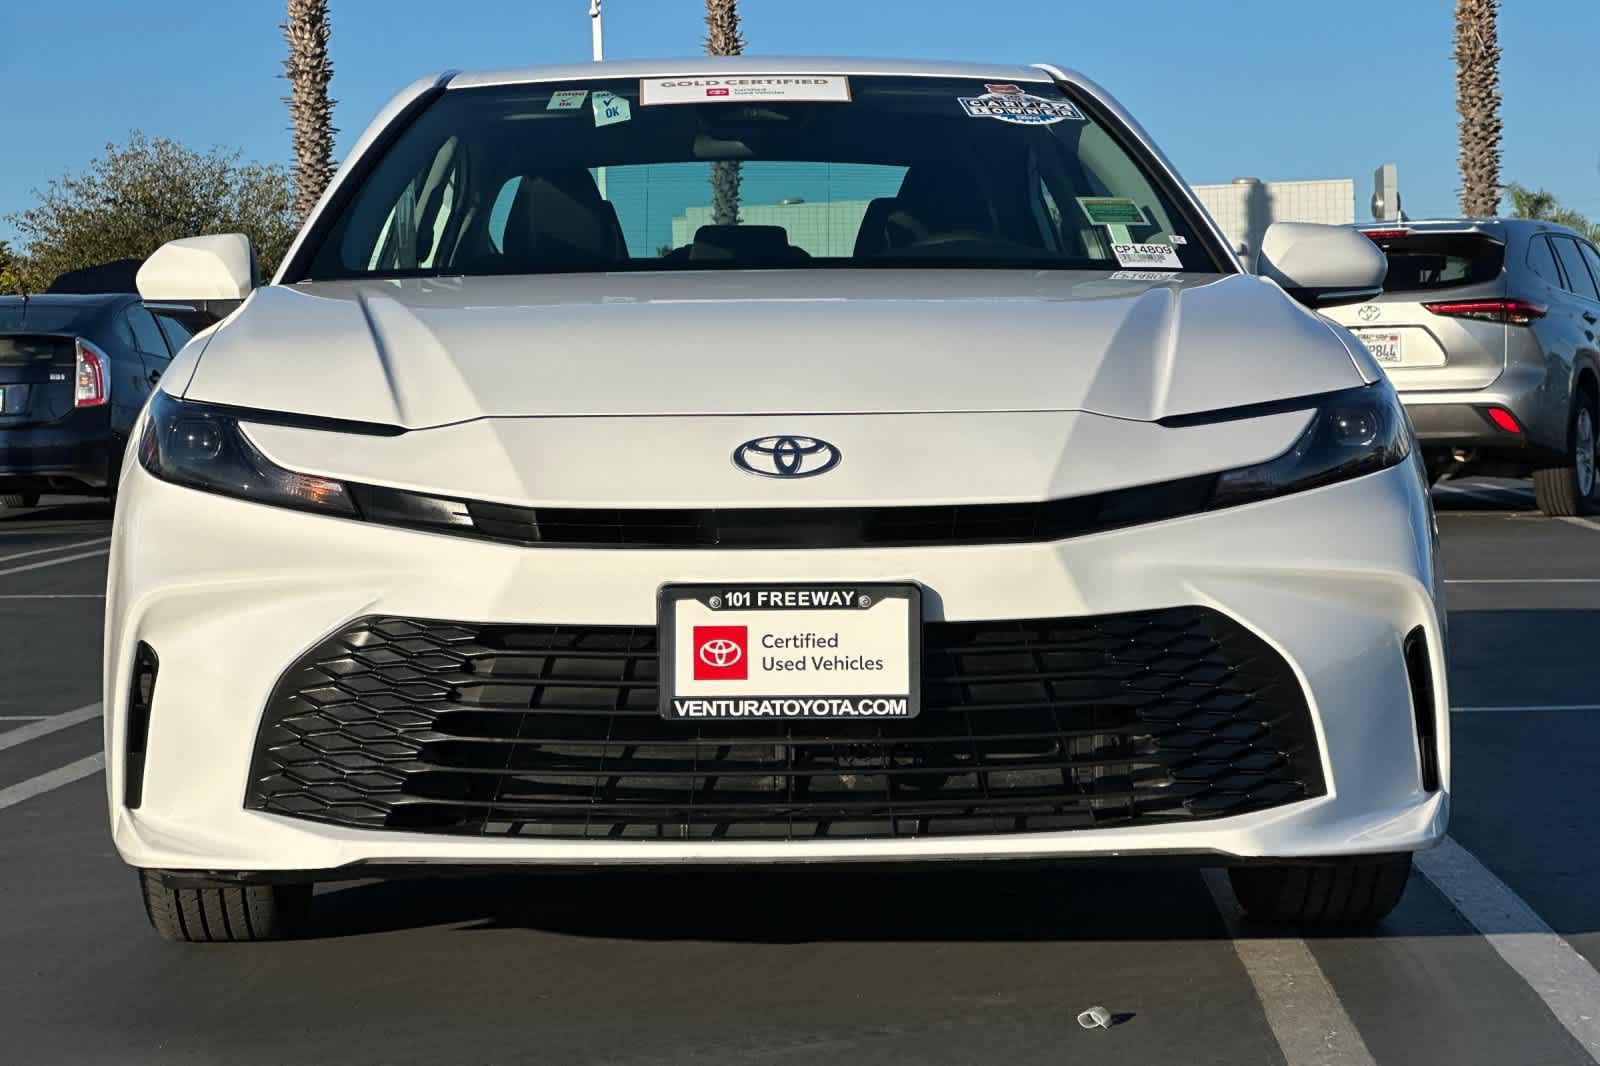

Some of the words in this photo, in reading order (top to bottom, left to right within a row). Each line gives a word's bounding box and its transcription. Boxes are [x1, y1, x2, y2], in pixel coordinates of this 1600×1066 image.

[660, 80, 721, 88] GOLD
[606, 106, 620, 118] OK
[969, 100, 1074, 110] CARFAX
[1115, 245, 1172, 254] CP14809
[1367, 343, 1396, 357] P844
[724, 592, 751, 607] 101
[757, 591, 855, 607] FREEWAY
[761, 633, 839, 649] Certified
[762, 656, 806, 671] Used
[811, 656, 884, 671] Vehicles
[674, 699, 907, 717] VENTURATOYOTA.COM
